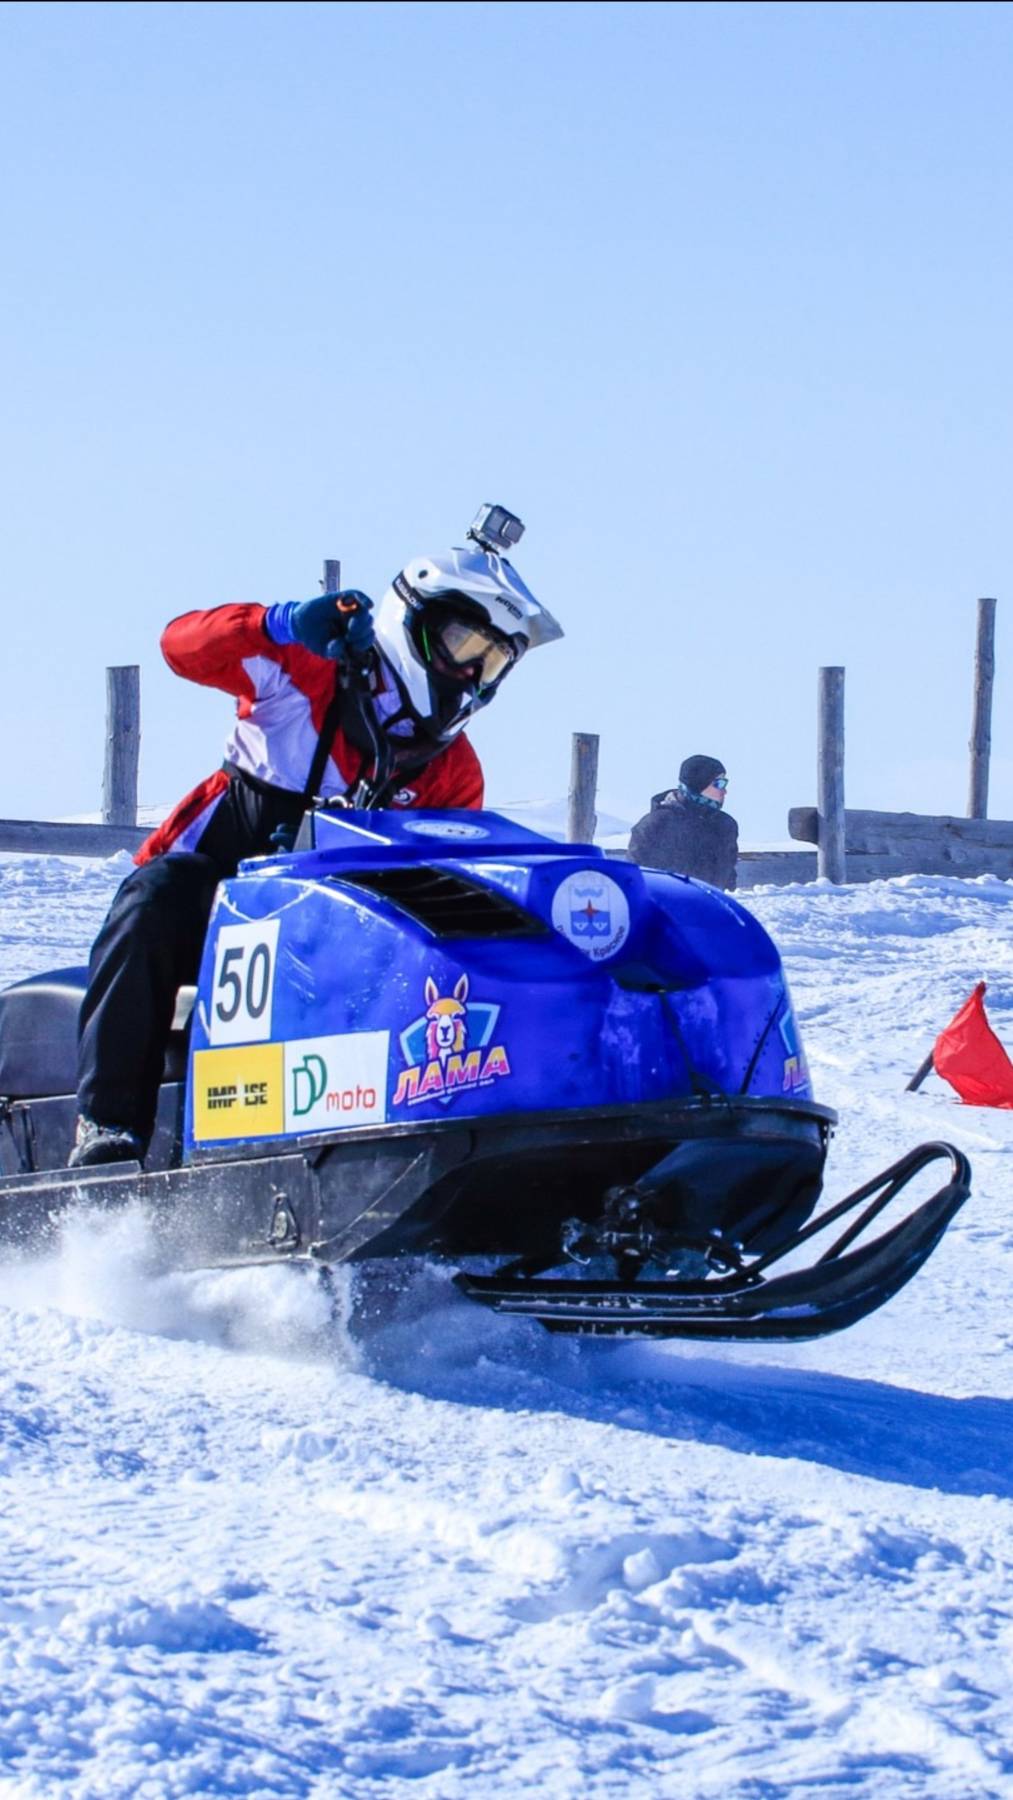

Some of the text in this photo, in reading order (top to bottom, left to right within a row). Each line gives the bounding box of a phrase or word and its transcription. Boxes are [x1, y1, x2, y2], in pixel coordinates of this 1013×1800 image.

[215, 942, 271, 1022] 50
[207, 1082, 268, 1110] IMPLSE
[393, 1046, 511, 1105] ЛАМА
[326, 1085, 376, 1112] moto
